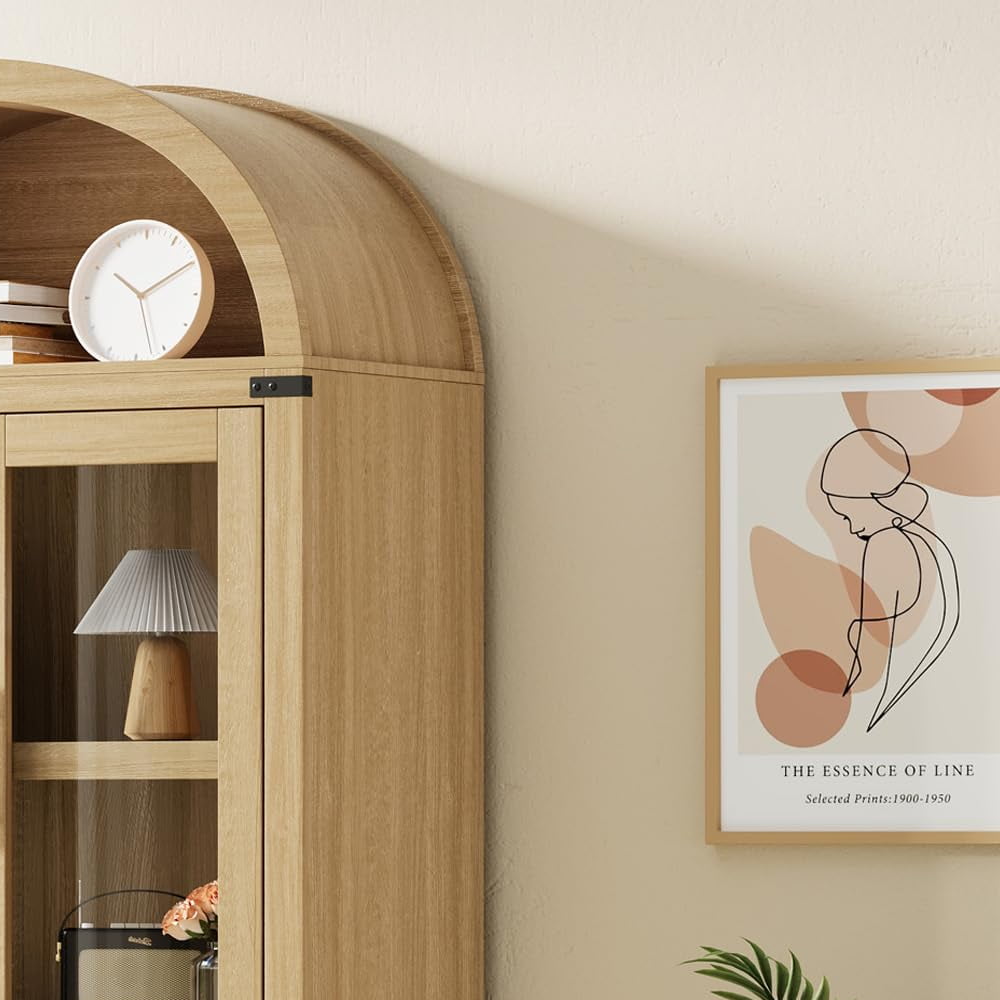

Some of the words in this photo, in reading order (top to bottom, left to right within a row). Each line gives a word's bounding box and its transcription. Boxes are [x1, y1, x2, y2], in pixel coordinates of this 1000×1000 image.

[781, 765, 815, 777] THE
[823, 765, 897, 777] ESSENCE
[904, 764, 927, 777] OF
[934, 764, 975, 777] LINE
[805, 793, 850, 804] Selected
[854, 793, 951, 804] Prints:1900-1950
